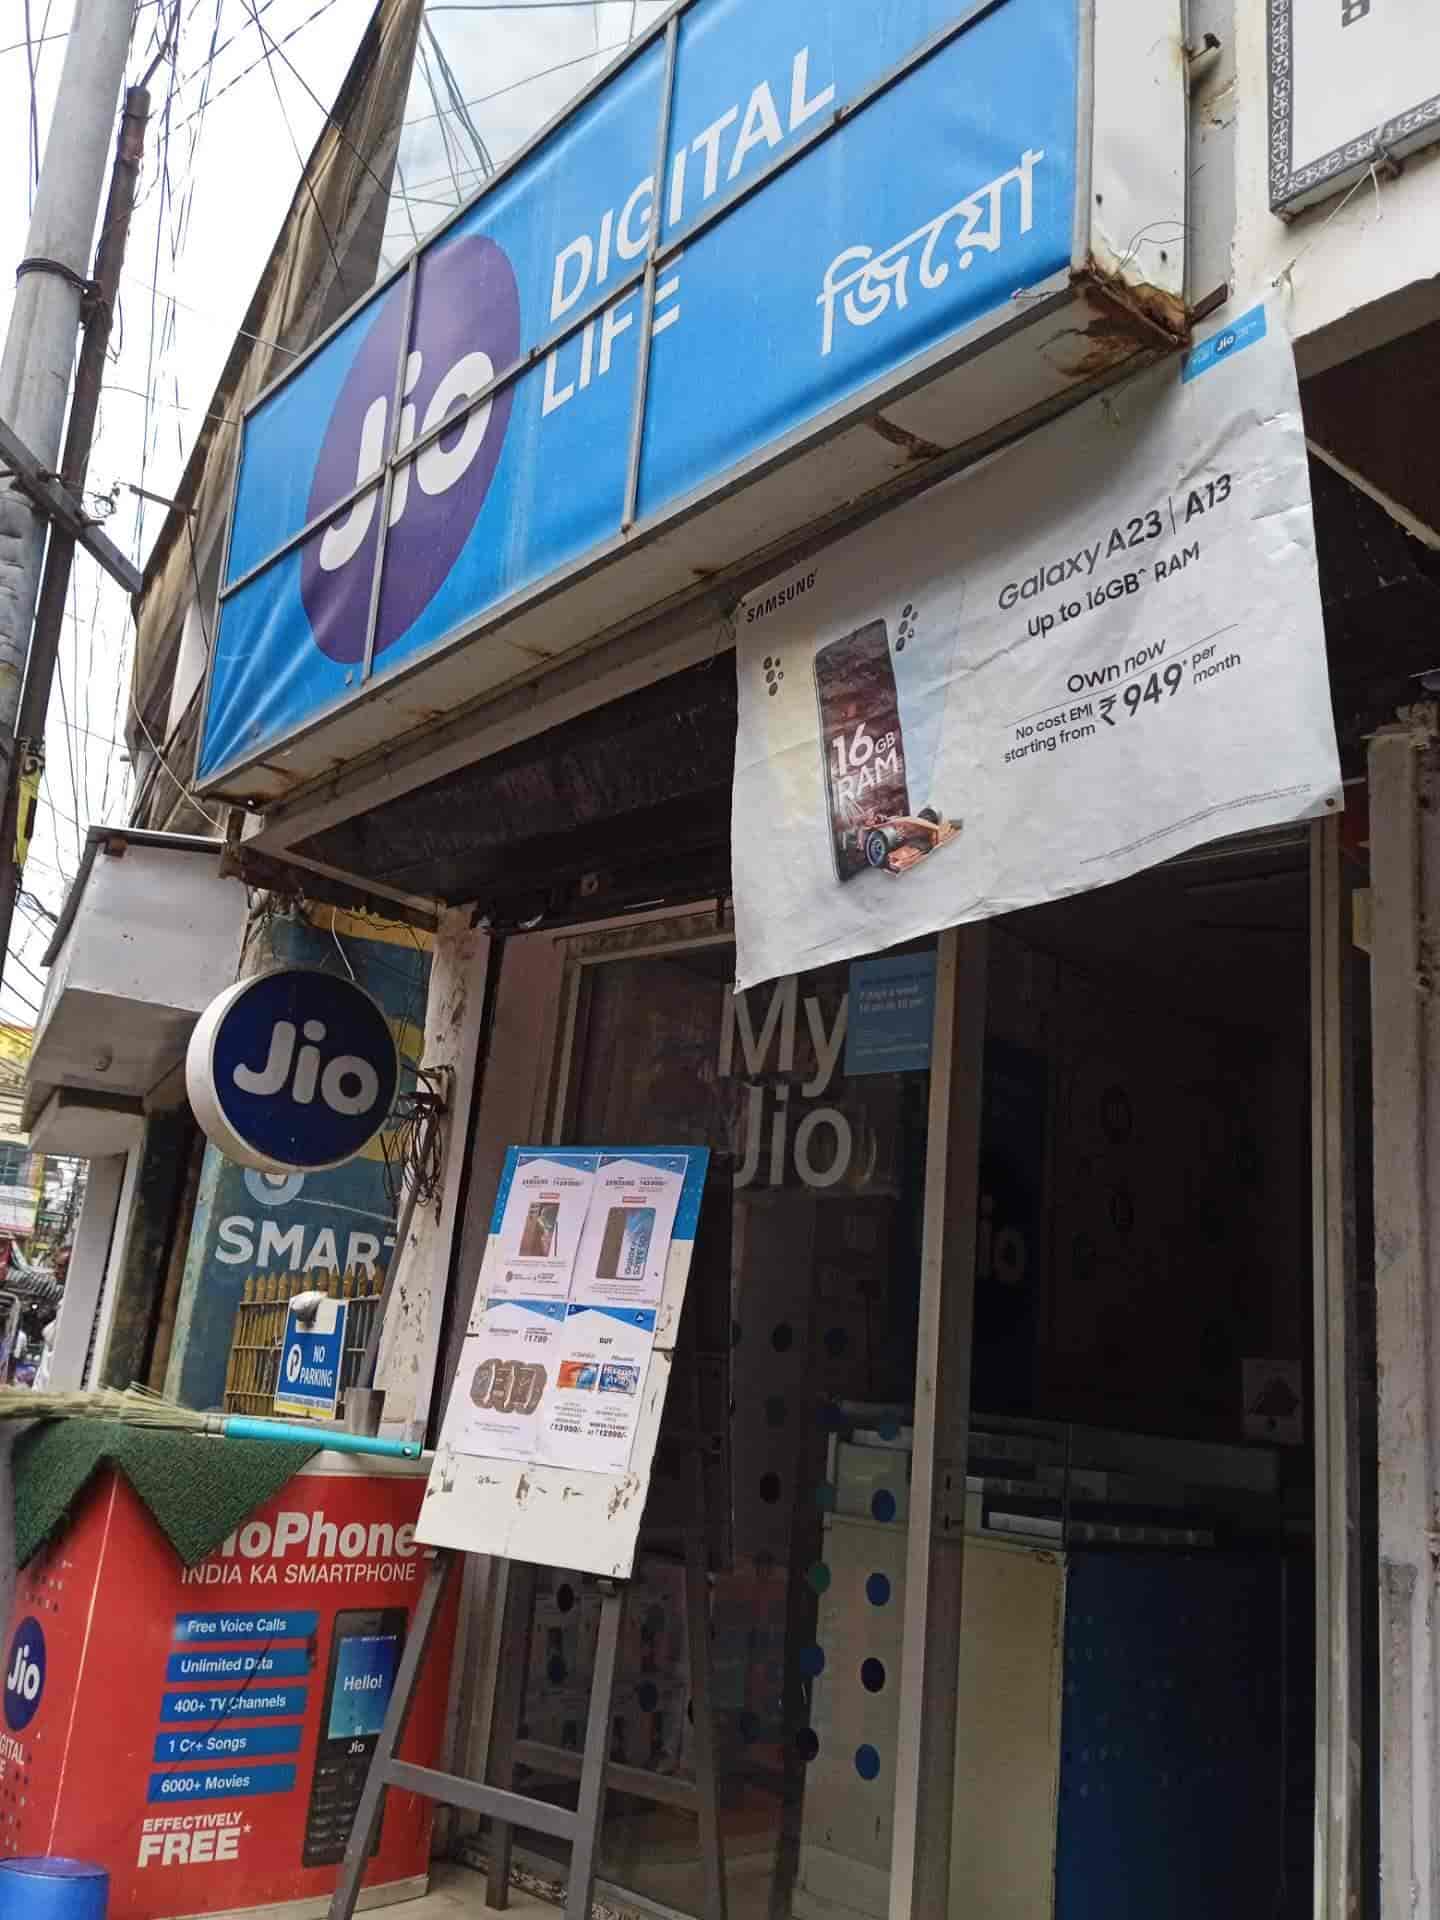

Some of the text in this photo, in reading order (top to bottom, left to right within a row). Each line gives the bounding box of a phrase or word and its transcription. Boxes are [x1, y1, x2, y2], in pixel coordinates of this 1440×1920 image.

[550, 45, 835, 321] DIGITAL
[816, 147, 1045, 357] জিয়ো
[541, 252, 681, 418] LIFE
[1216, 334, 1236, 353] Jio
[318, 349, 495, 571] Jio
[998, 473, 1232, 610] Galaxy A23 A13
[746, 572, 816, 624] SAMSUNG
[1028, 612, 1055, 639] Up
[1059, 600, 1082, 622] to
[1154, 540, 1200, 583] RAM
[1066, 639, 1167, 693] Own now
[1191, 644, 1217, 669] per
[1192, 652, 1242, 685] month
[1015, 703, 1094, 741] No cost EMI
[1004, 723, 1096, 763] starting from
[838, 746, 899, 808] RAM
[717, 974, 849, 1098] My
[232, 1018, 380, 1116] Jio
[733, 1082, 852, 1189] Jio
[313, 1345, 326, 1363] NO
[299, 1367, 333, 1388] PARKING
[181, 1562, 417, 1585] INDIA KA SMARTPHONE
[187, 1617, 288, 1633] Free Voice Calls
[7, 1643, 41, 1701] Jio
[181, 1656, 242, 1673] Unlimited
[343, 1673, 383, 1692] Hello!
[173, 1694, 287, 1713] 400+ TV Channels
[168, 1738, 176, 1753] 1
[206, 1737, 248, 1752] Songs
[347, 1739, 366, 1755] Jio
[161, 1774, 251, 1793] 6000+ Movies
[142, 1810, 243, 1833] EFFECTIVELY
